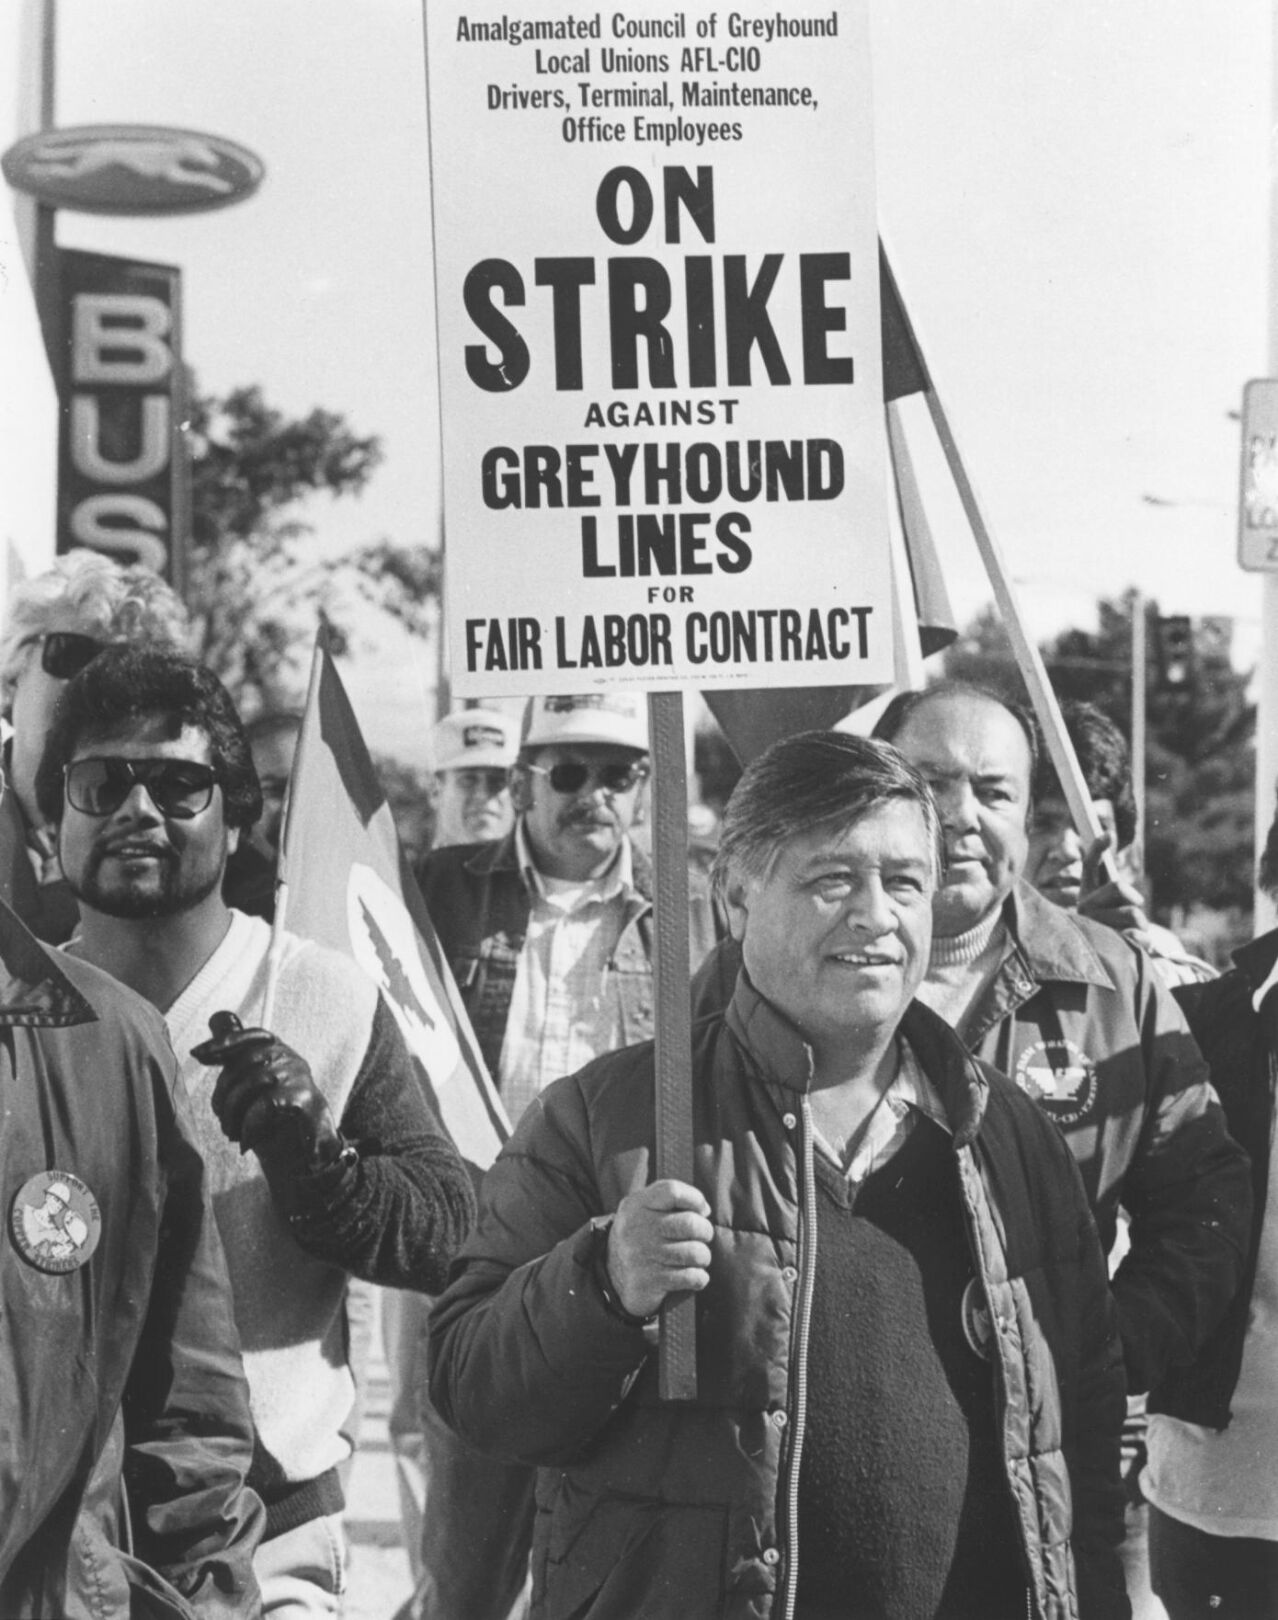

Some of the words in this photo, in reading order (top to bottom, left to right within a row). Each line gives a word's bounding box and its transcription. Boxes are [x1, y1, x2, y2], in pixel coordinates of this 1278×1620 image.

[456, 13, 601, 46] Amalgamated
[611, 12, 686, 39] Council
[696, 12, 717, 38] of
[728, 11, 838, 43] Greyhound
[535, 47, 591, 74] Local
[601, 47, 670, 73] Unions
[680, 46, 761, 73] AFL-CIO
[487, 83, 571, 112] Drivers,
[577, 81, 674, 110] Terminal,
[682, 81, 818, 109] Maintenance,
[562, 116, 626, 143] Office
[633, 116, 743, 147] Employees
[595, 165, 716, 246] ON
[462, 251, 854, 393] STRIKE
[72, 293, 171, 570] BUS
[583, 399, 739, 428] AGAINST
[481, 438, 845, 511] GREYHOUND
[580, 511, 753, 578] LINES
[647, 585, 694, 604] FOR
[465, 617, 543, 673] FAIR
[555, 613, 674, 669] LABOR
[685, 606, 874, 665] CONTRACT
